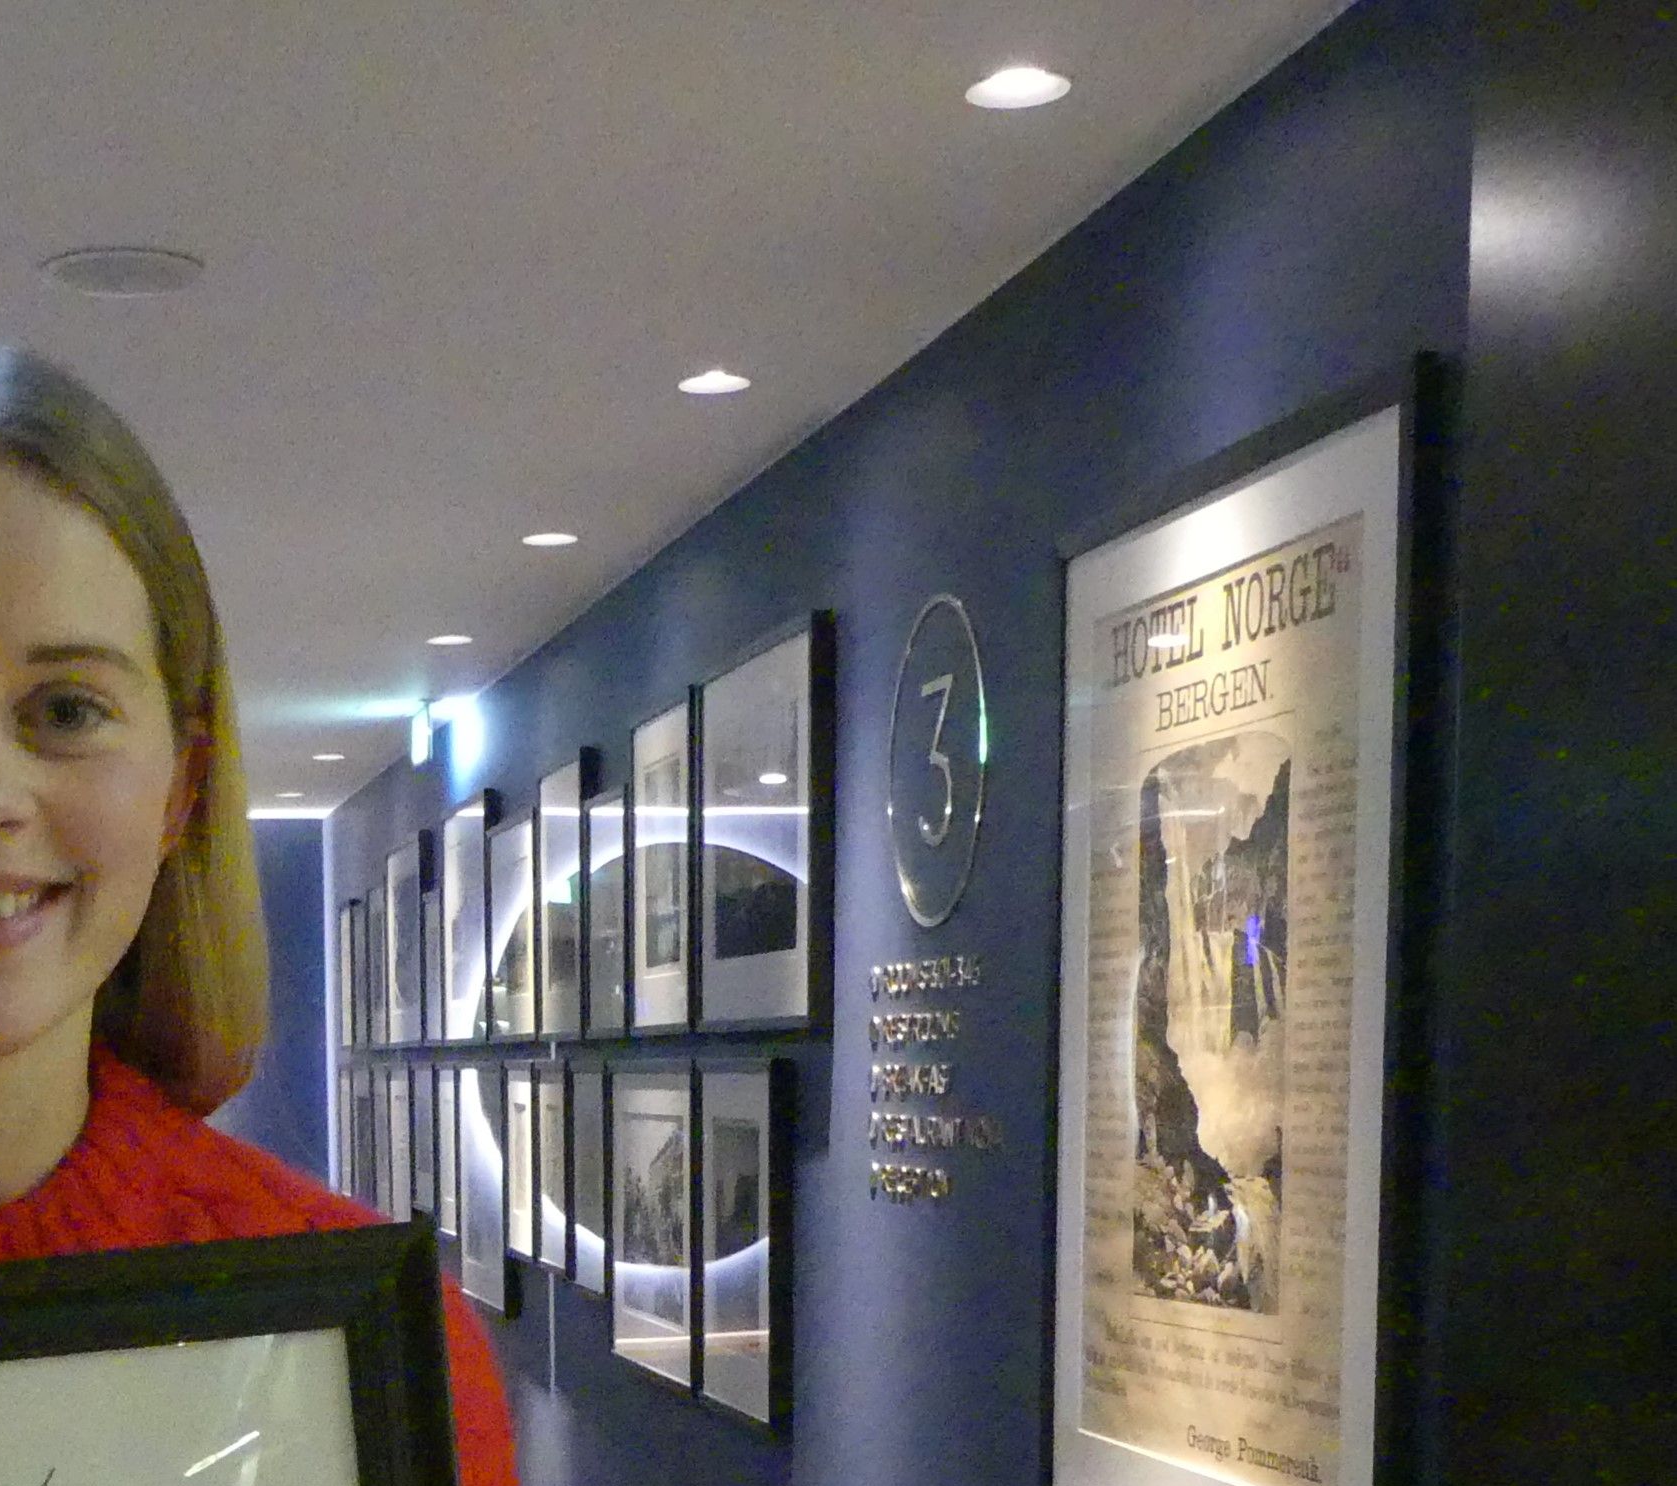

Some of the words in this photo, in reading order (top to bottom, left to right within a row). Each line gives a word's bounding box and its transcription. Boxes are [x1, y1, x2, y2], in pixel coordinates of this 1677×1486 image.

[1111, 596, 1205, 689] HOTEL
[1221, 542, 1337, 652] NORGE
[919, 673, 954, 847] 3
[1187, 1424, 1231, 1462] George
